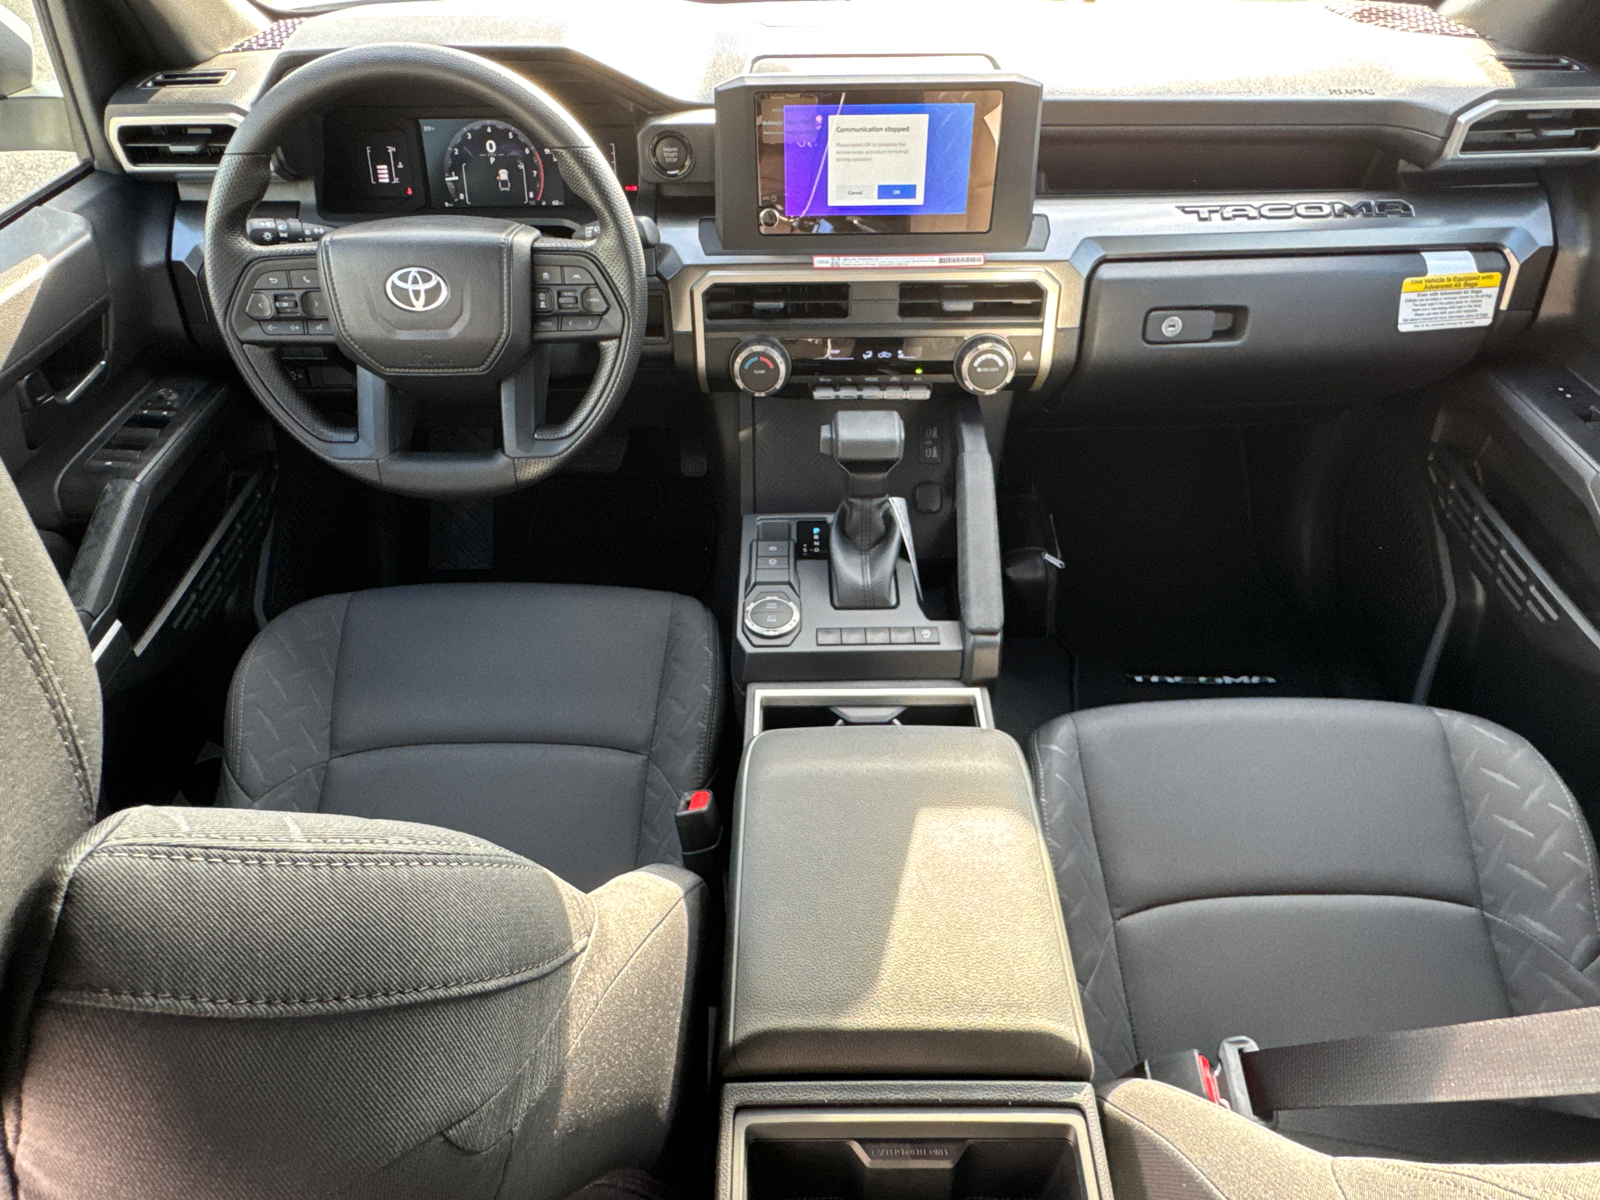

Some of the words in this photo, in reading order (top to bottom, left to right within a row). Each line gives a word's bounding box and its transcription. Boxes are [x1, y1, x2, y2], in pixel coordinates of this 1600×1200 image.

[836, 125, 883, 133] Communication
[885, 125, 910, 133] stopped
[466, 132, 472, 140] 3
[485, 139, 497, 154] 0
[454, 147, 459, 155] 2
[524, 147, 531, 155] 6
[1175, 199, 1416, 222] TACOMA
[1464, 281, 1479, 289] Bags
